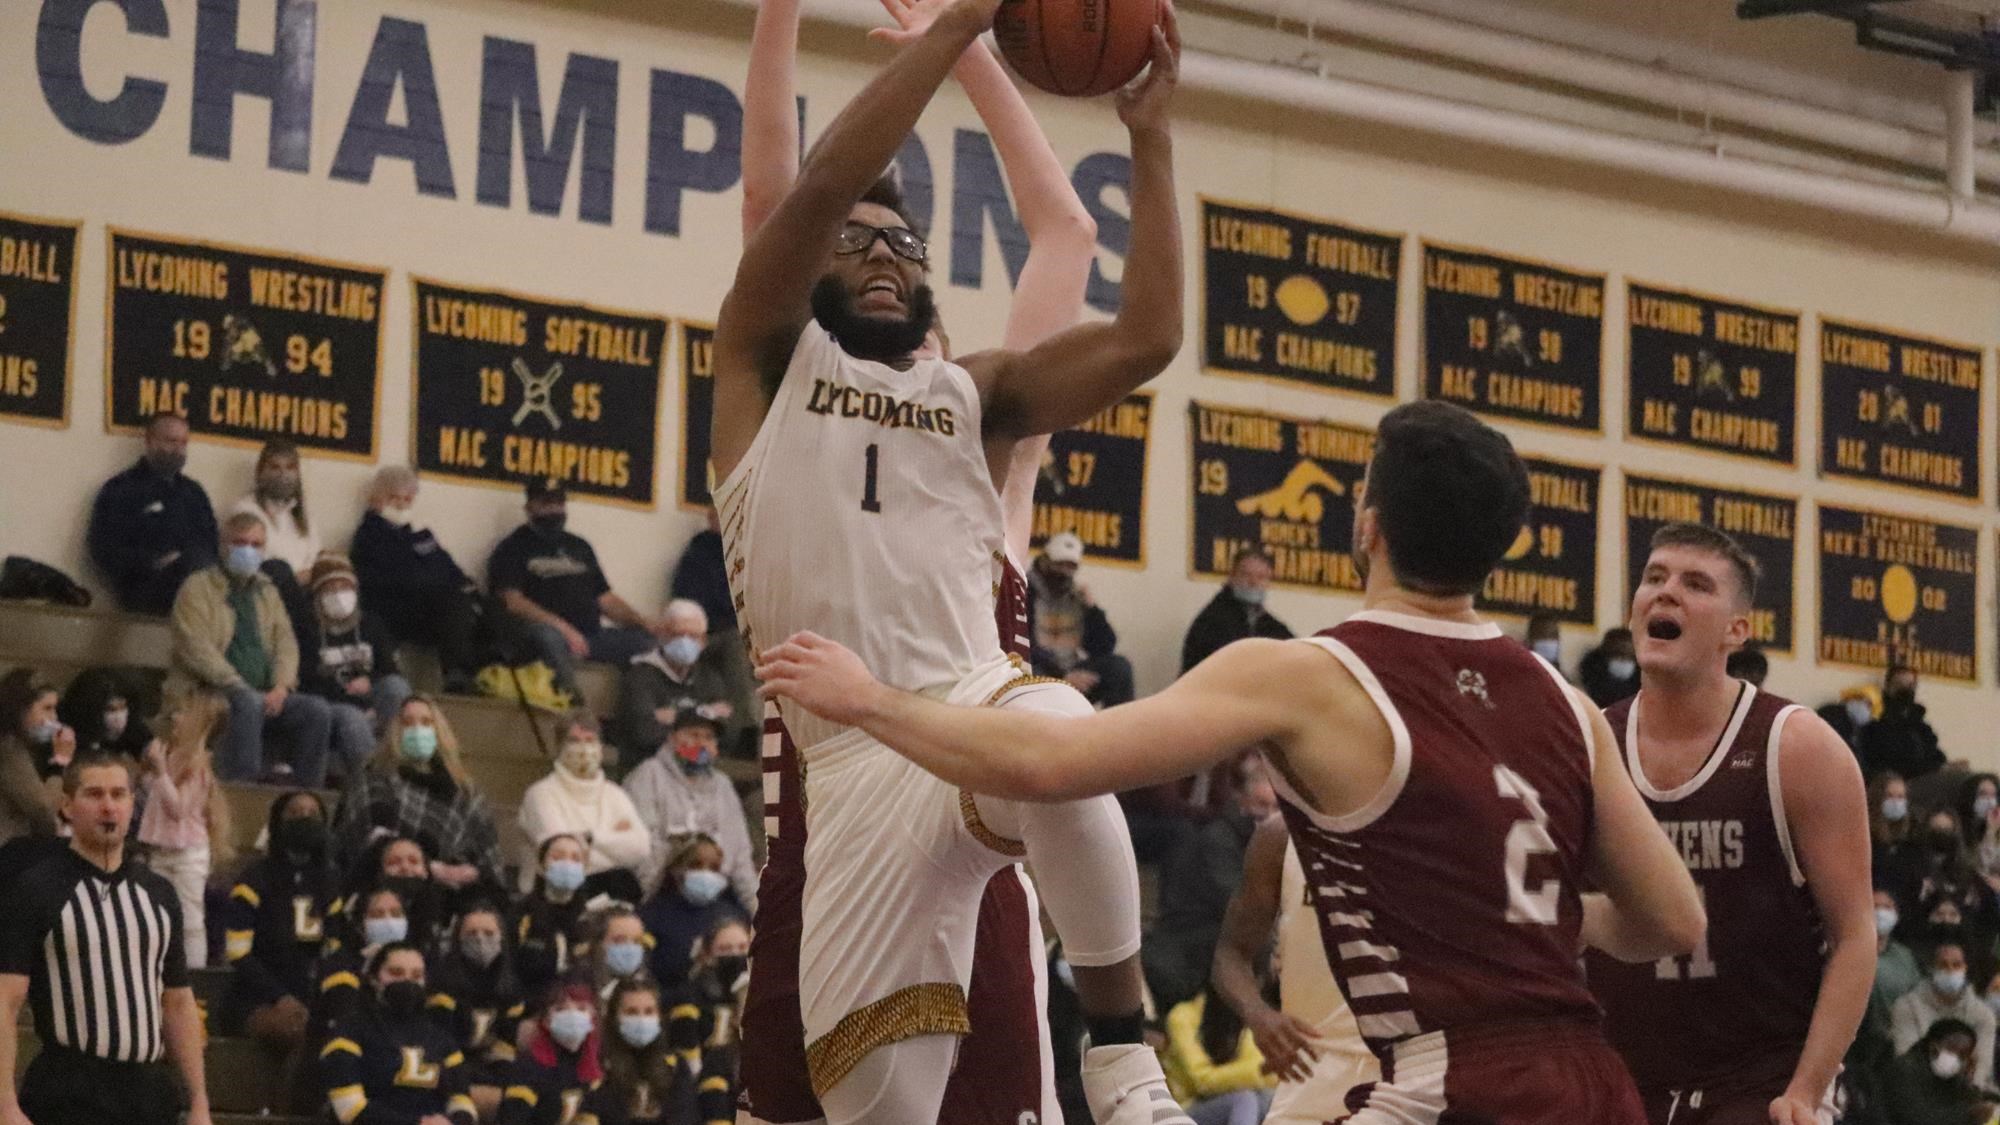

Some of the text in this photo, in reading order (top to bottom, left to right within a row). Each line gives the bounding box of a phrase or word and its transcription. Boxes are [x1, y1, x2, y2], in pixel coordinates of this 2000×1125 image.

[1208, 214, 1390, 280] LYCOMING FOOTBALL
[118, 248, 376, 322] LYCOMING WRESTLING
[1246, 273, 1361, 326] 19 97
[1426, 255, 1600, 319] LYCOMING WRESTLING
[173, 320, 333, 377] 19 94
[425, 295, 651, 367] LYCOMING SOFTBALL
[1468, 316, 1487, 350] 19
[1630, 293, 1798, 354] LYCOMING WRESTLING
[1224, 324, 1376, 382] MAC CHAMPIONS
[1672, 354, 1692, 386] 19
[1823, 330, 1979, 390] LYCOMING WRESTLING
[139, 376, 348, 439] MAC CHAMPIONS
[478, 368, 602, 422] 19 95
[806, 378, 955, 437] LYCOMING
[1441, 364, 1583, 420] MAC CHAMPIONS
[1201, 408, 1282, 452] LYCOMING
[1643, 398, 1779, 453] MAC CHAMPIONS
[438, 426, 630, 489] MAC CHAMPIONS
[861, 443, 881, 513] 1
[1068, 452, 1096, 487] 97
[1200, 458, 1228, 495] 19
[1837, 436, 1963, 487] MAC CHAMPIONS
[1628, 484, 1793, 540] LYCOMING FOOTBALL
[1876, 537, 1974, 574] BASKETBALL
[1493, 763, 1559, 926] 2
[395, 1047, 441, 1088] L
